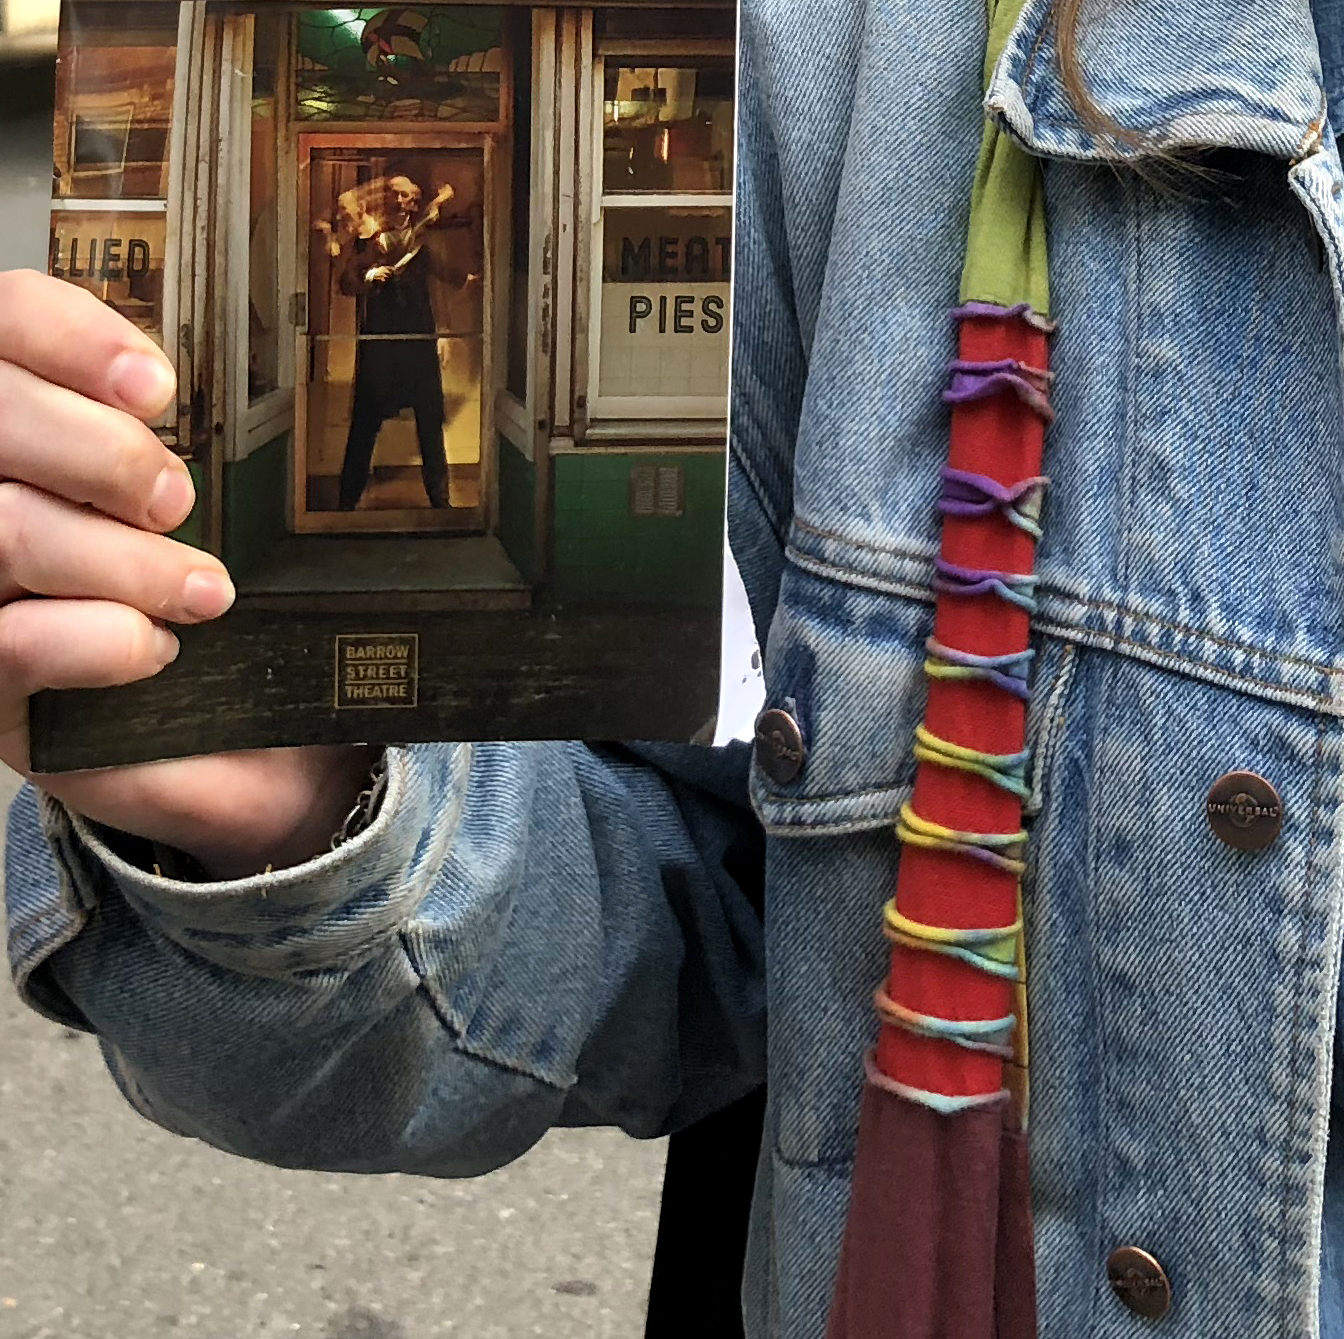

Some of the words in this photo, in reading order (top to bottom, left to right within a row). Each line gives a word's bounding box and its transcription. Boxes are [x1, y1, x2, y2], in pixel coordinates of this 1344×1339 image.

[620, 235, 732, 278] MEAT
[628, 294, 725, 335] PIES
[345, 645, 410, 659] BARROW
[346, 664, 408, 679] STREET
[344, 684, 409, 699] THEATRE
[1207, 802, 1279, 818] UNIVERSAL
